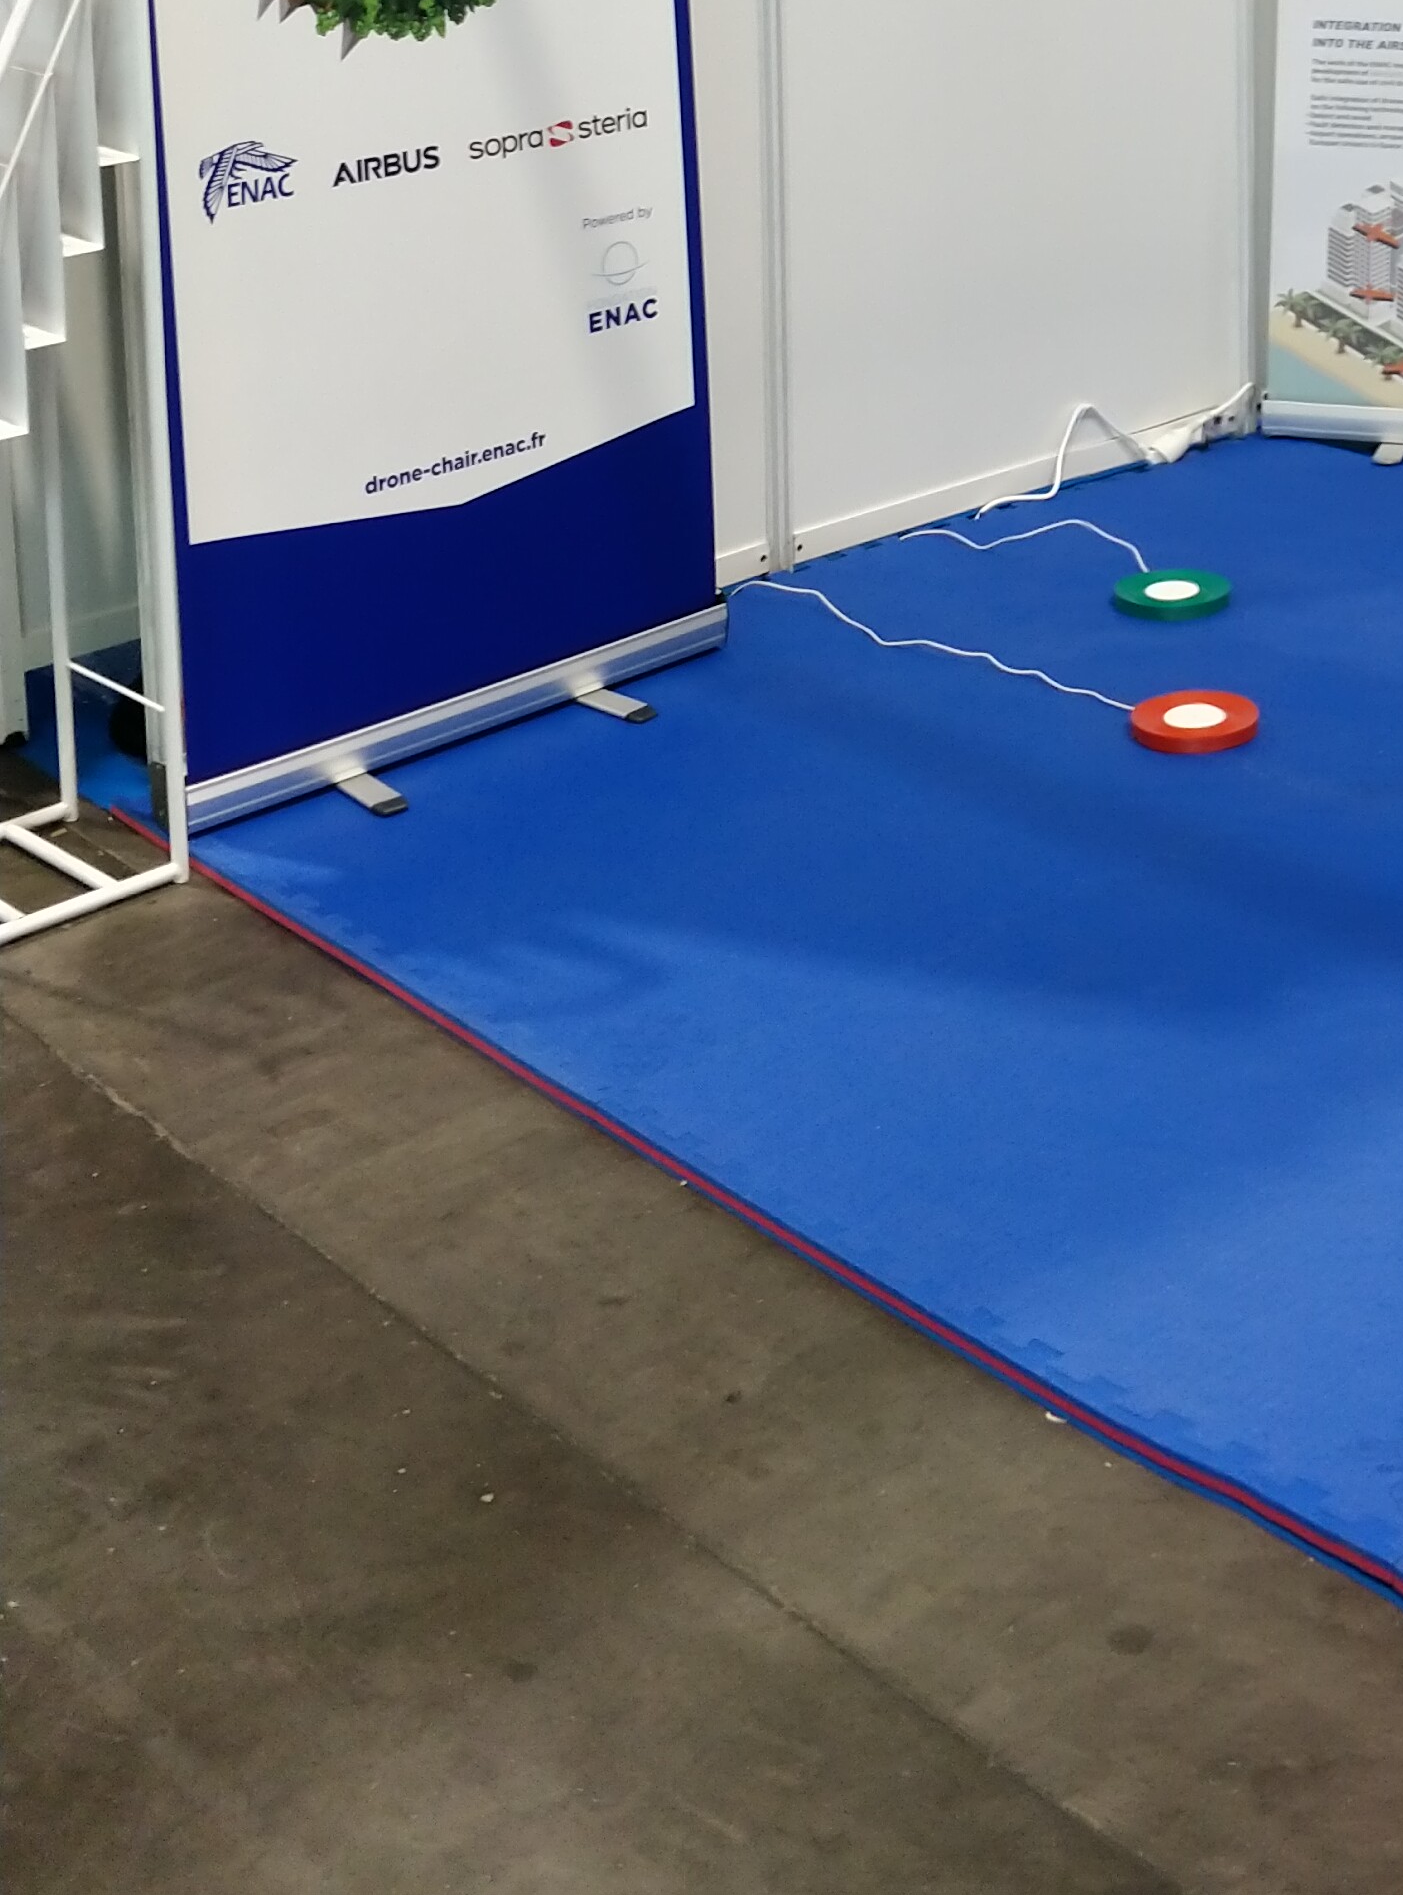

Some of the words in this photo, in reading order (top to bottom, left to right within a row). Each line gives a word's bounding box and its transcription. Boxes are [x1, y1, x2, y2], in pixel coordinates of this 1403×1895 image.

[1312, 20, 1402, 33] INTEGRATION
[1312, 38, 1344, 48] INTO
[1348, 39, 1373, 50] THE
[468, 127, 544, 161] sopra
[578, 107, 649, 139] steria
[332, 145, 441, 187] AIRBUS
[227, 173, 295, 209] ENAC
[582, 209, 634, 230] Powered
[634, 205, 654, 223] by
[588, 298, 659, 334] ENAC
[365, 431, 547, 495] drone-chair.enac.fr
